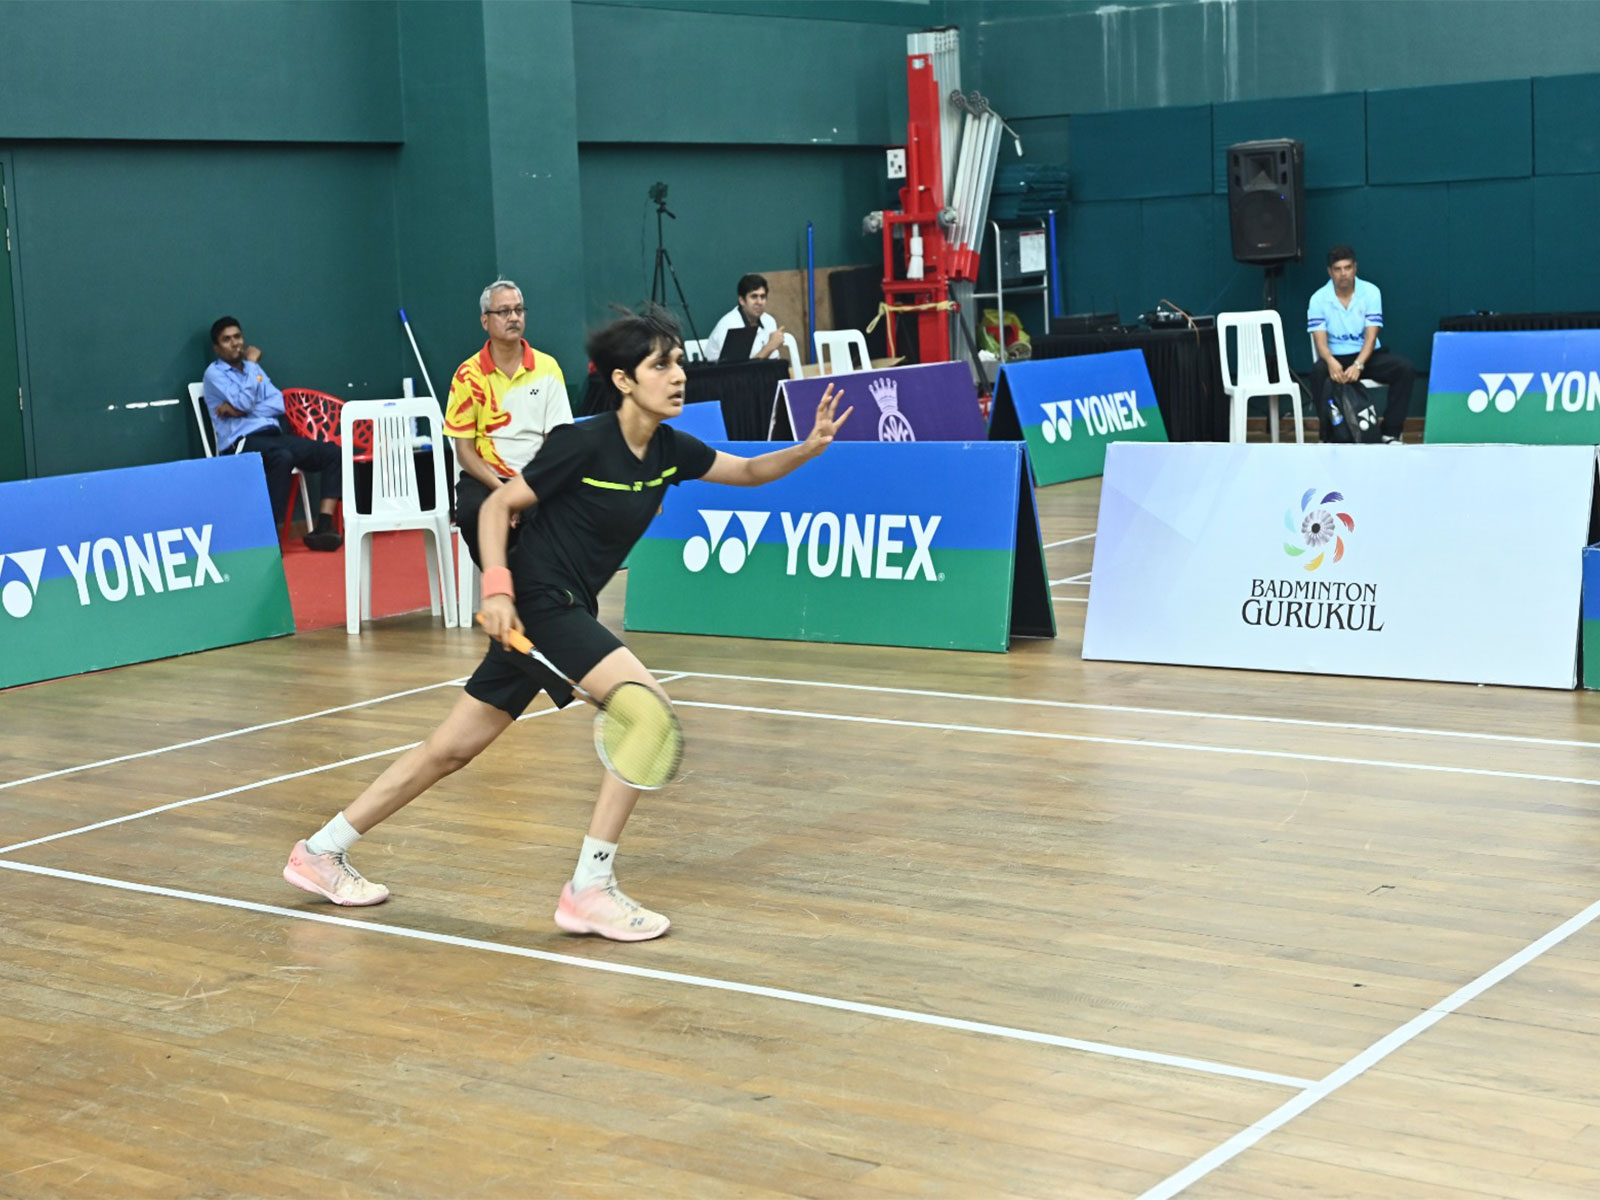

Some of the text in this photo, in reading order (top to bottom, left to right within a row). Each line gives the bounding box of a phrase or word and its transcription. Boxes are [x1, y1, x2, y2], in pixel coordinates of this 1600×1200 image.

[1074, 390, 1147, 436] YONEX
[57, 524, 224, 606] YONEX
[780, 511, 942, 581] YONEX
[1250, 579, 1378, 602] BADMINTON
[1241, 599, 1385, 632] GURUKUL
